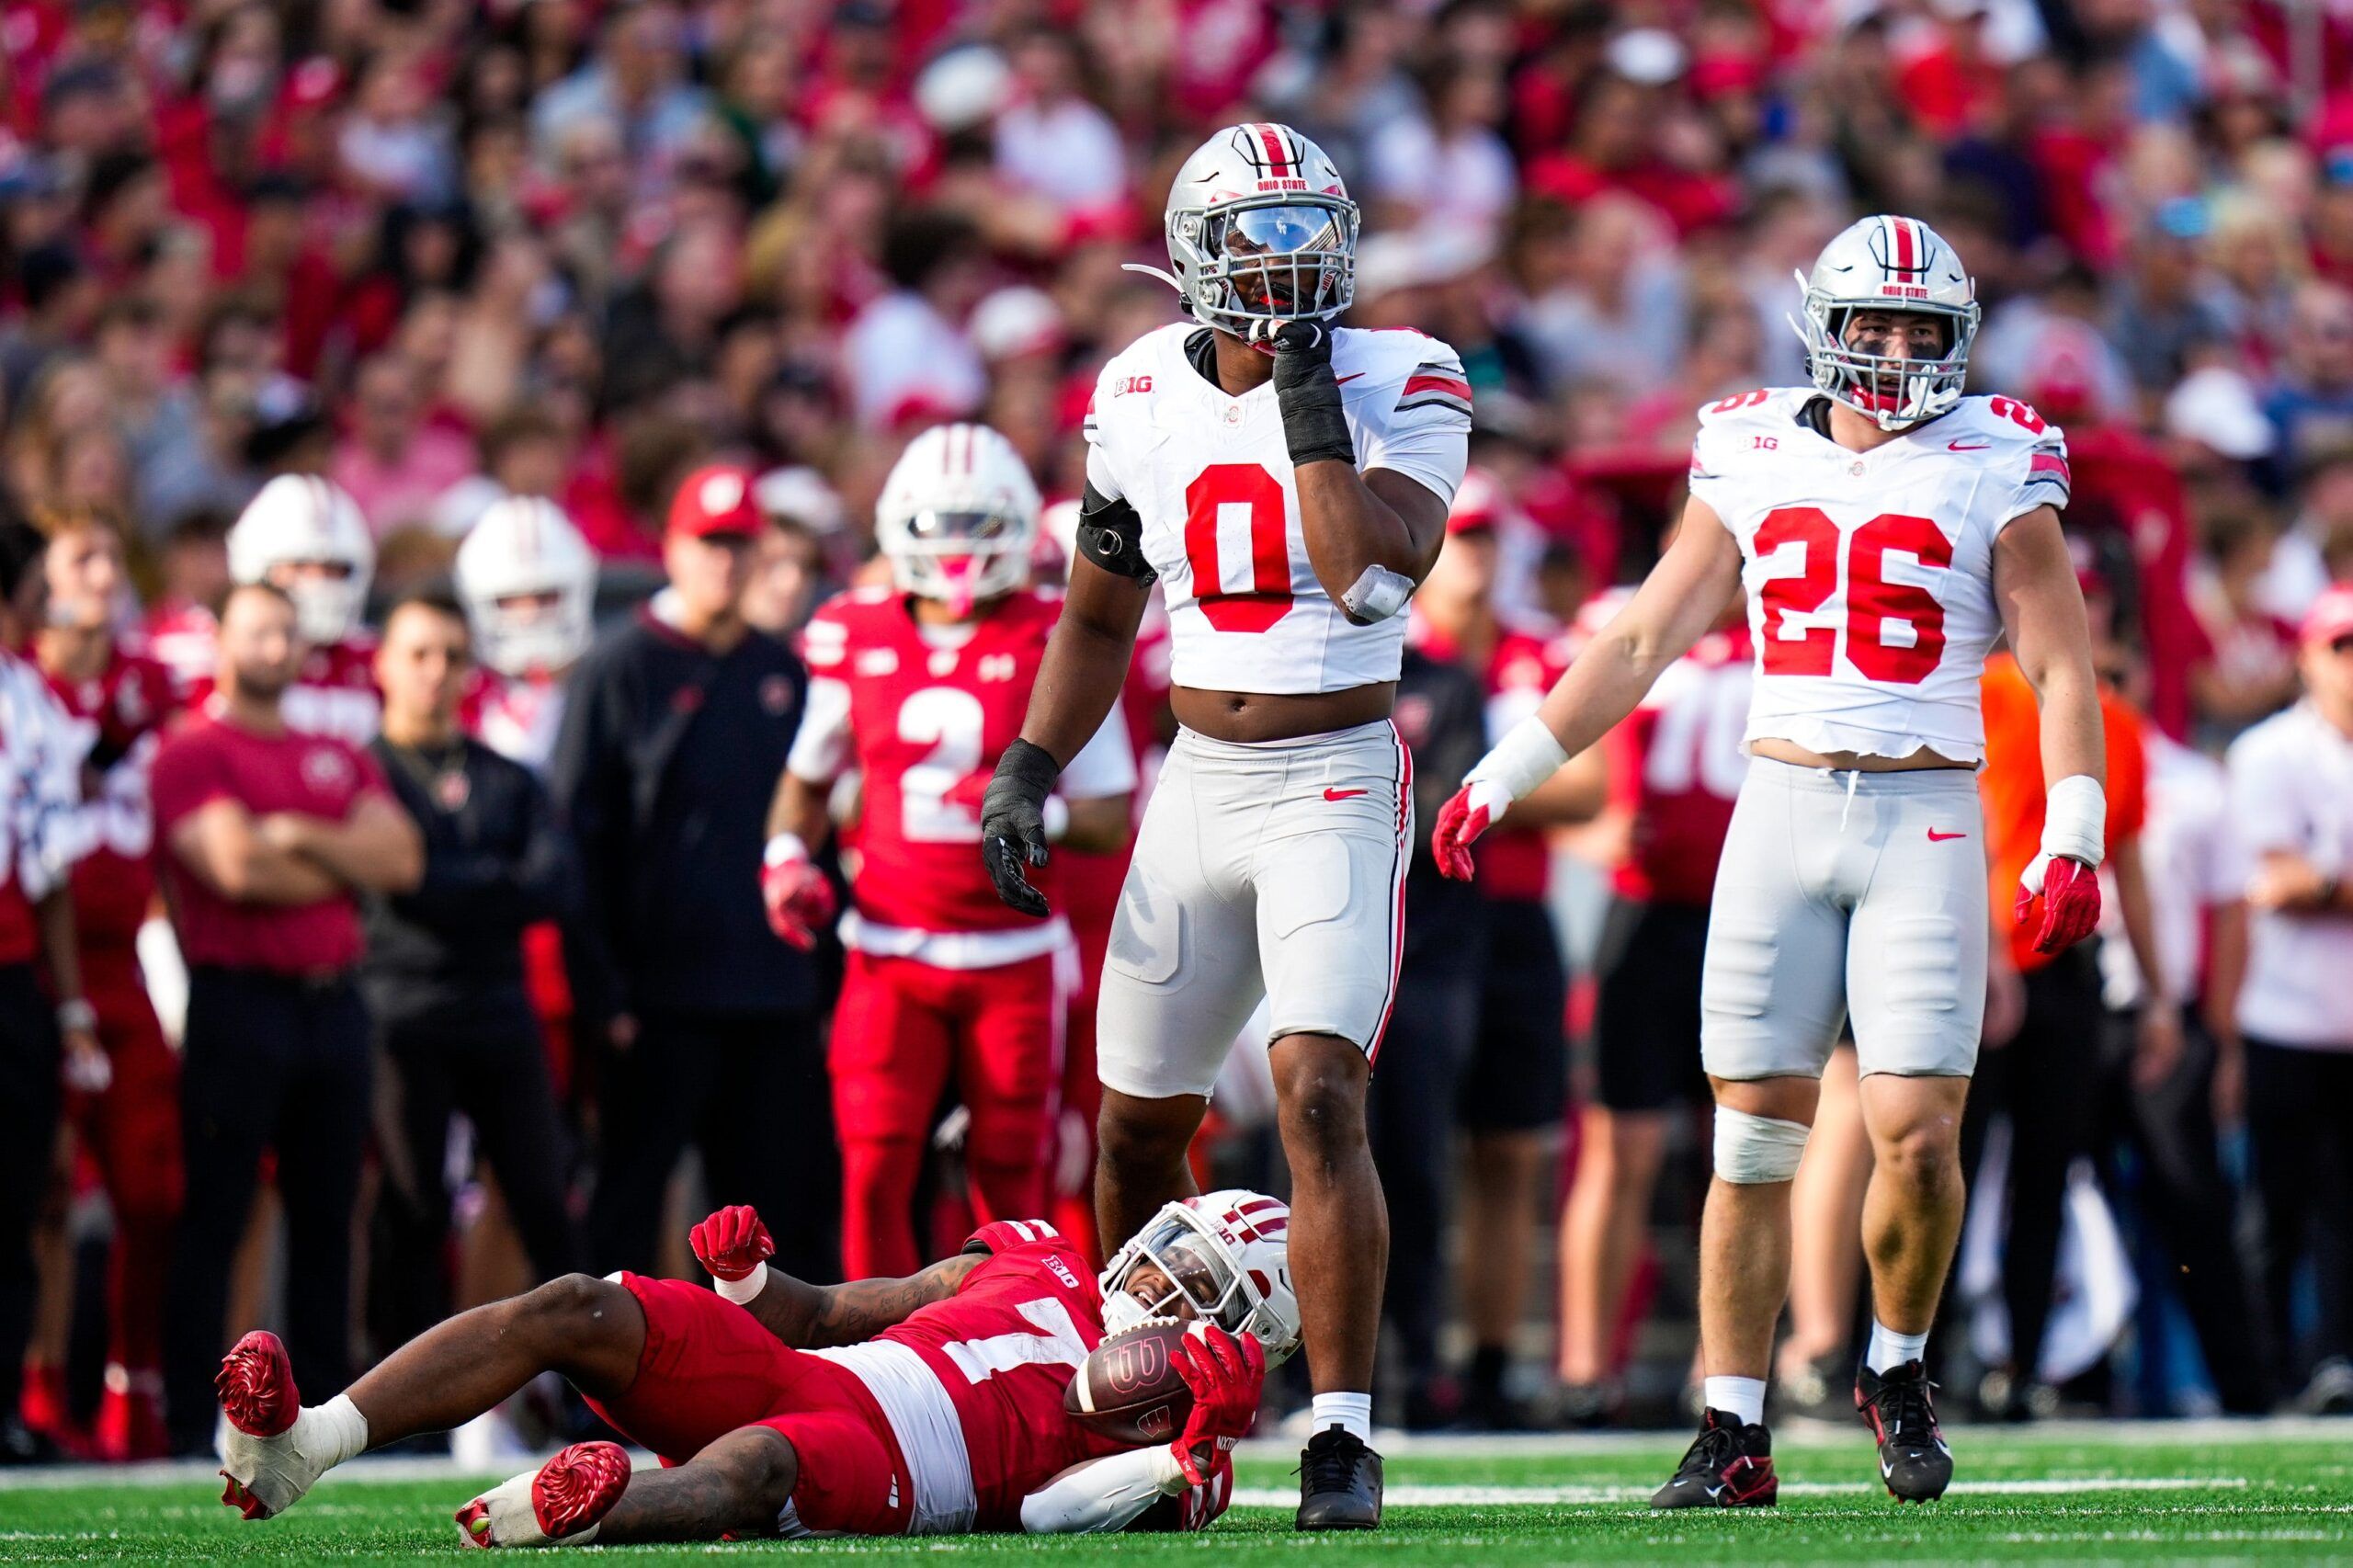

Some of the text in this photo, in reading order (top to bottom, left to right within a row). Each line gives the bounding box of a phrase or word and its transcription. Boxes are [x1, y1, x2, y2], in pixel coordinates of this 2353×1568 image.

[1257, 179, 1307, 191] OHIO STATE
[1882, 285, 1927, 299] OHIO STATE
[1184, 463, 1293, 633] 0
[1753, 506, 1954, 685] 26
[898, 686, 984, 843] 2
[942, 1297, 1091, 1386] 7
[1103, 1335, 1167, 1394] W
